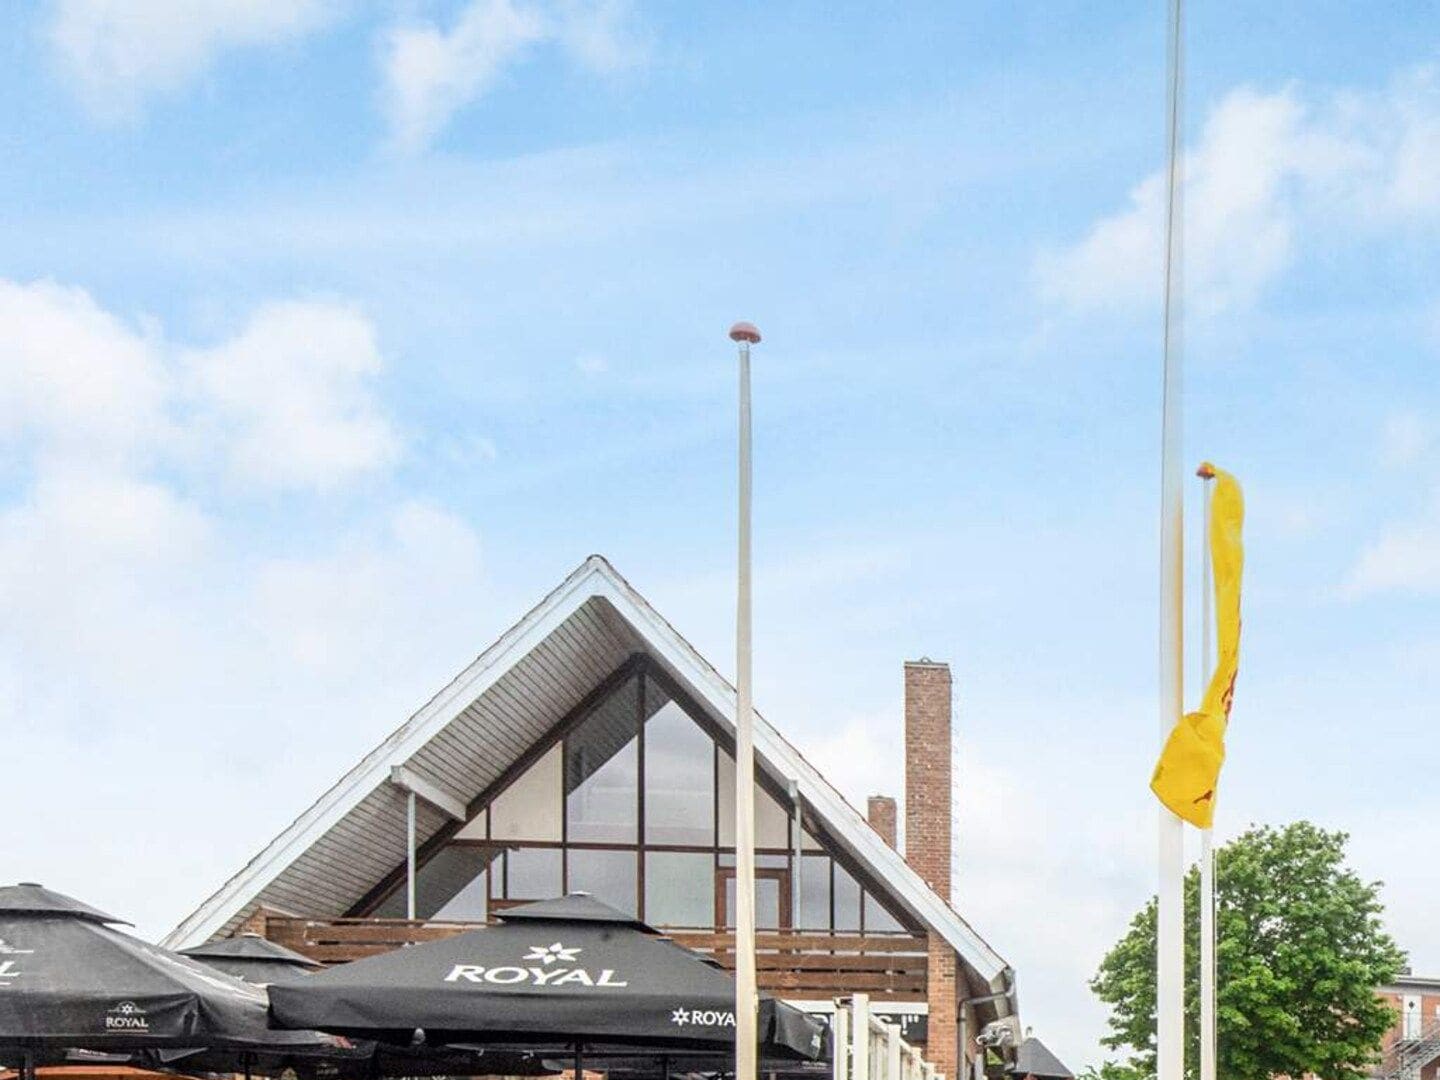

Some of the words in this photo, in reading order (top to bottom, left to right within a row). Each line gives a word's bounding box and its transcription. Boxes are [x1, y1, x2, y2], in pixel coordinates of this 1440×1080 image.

[444, 964, 627, 988] ROYAL
[106, 1017, 148, 1028] ROYAL
[691, 1011, 738, 1027] ROYA
